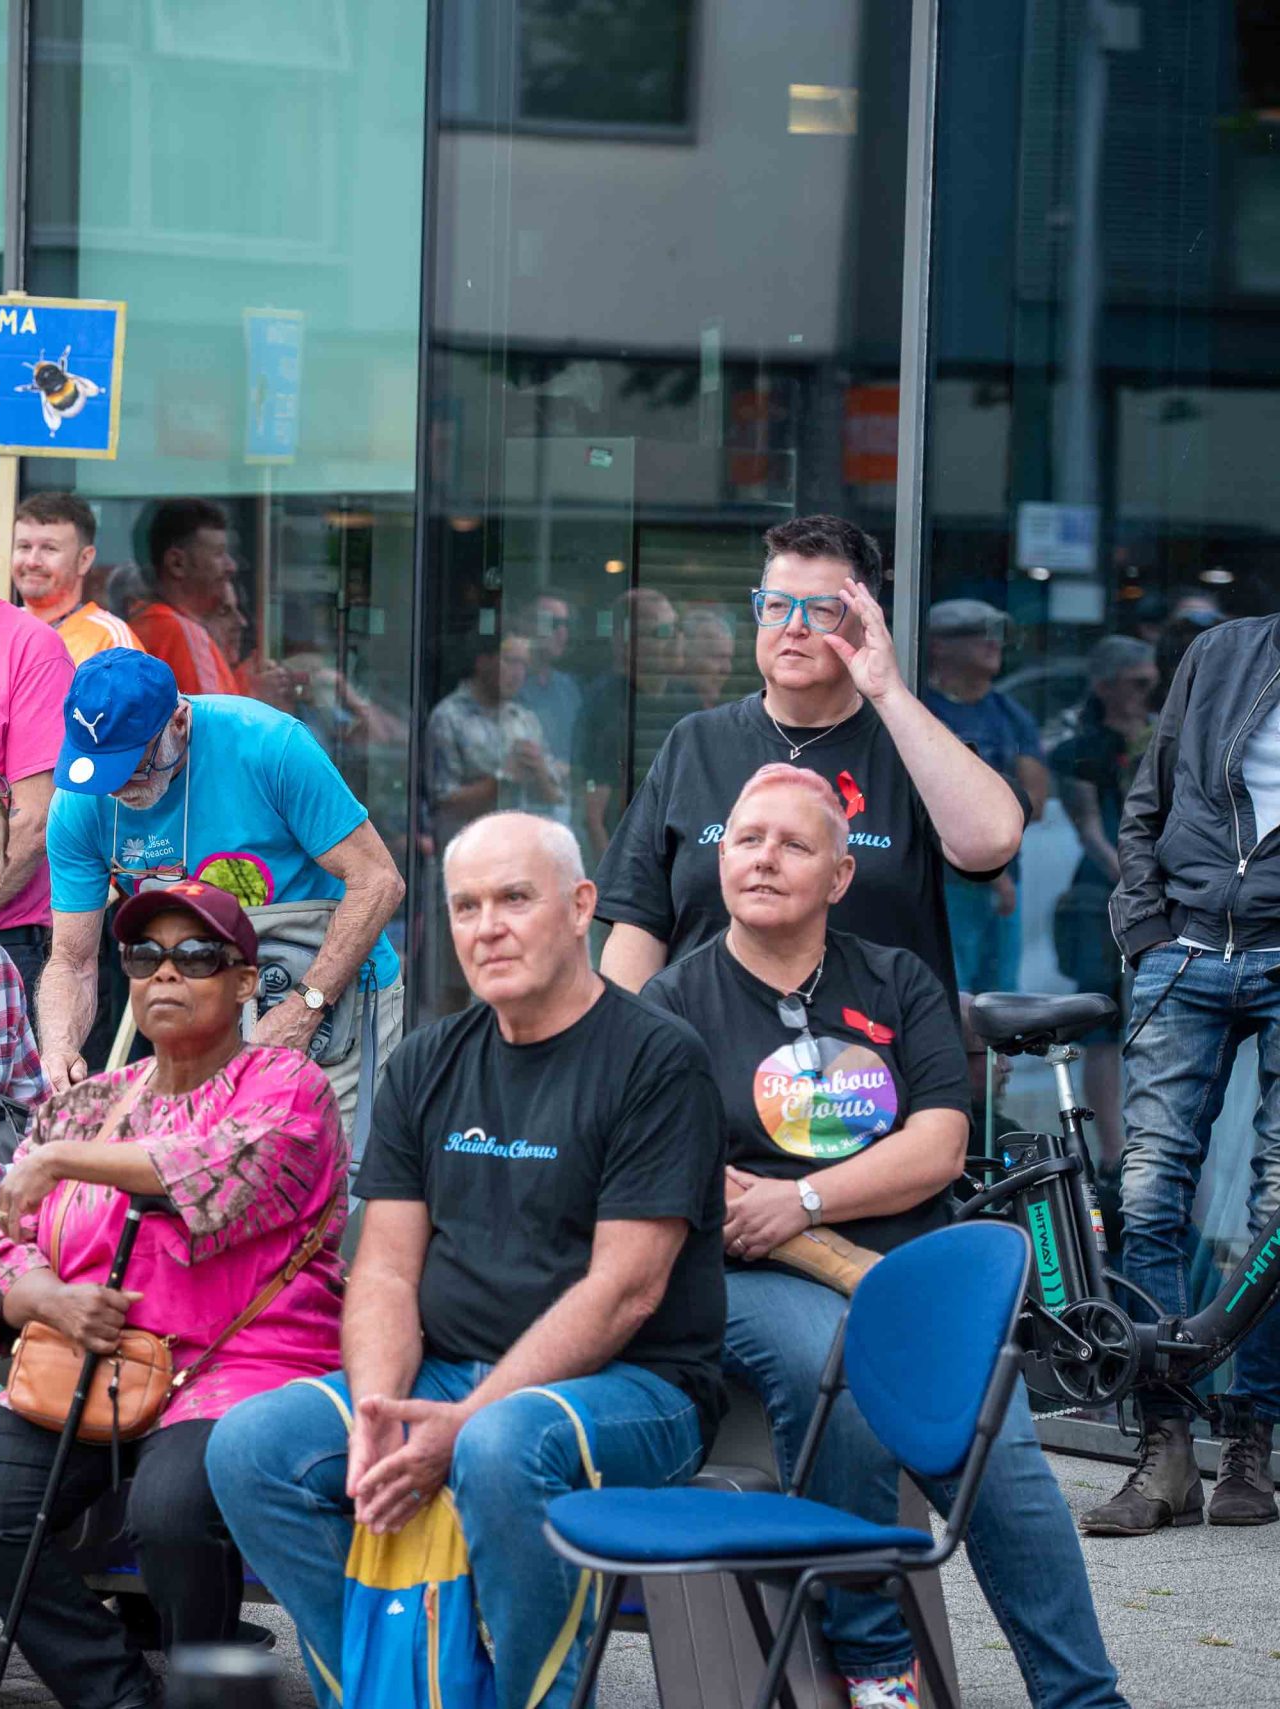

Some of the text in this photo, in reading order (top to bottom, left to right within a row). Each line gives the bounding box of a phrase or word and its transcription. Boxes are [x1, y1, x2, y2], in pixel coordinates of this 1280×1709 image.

[847, 832, 892, 849] orus
[781, 1096, 876, 1122] Chorus
[1034, 1206, 1054, 1268] HITWAY
